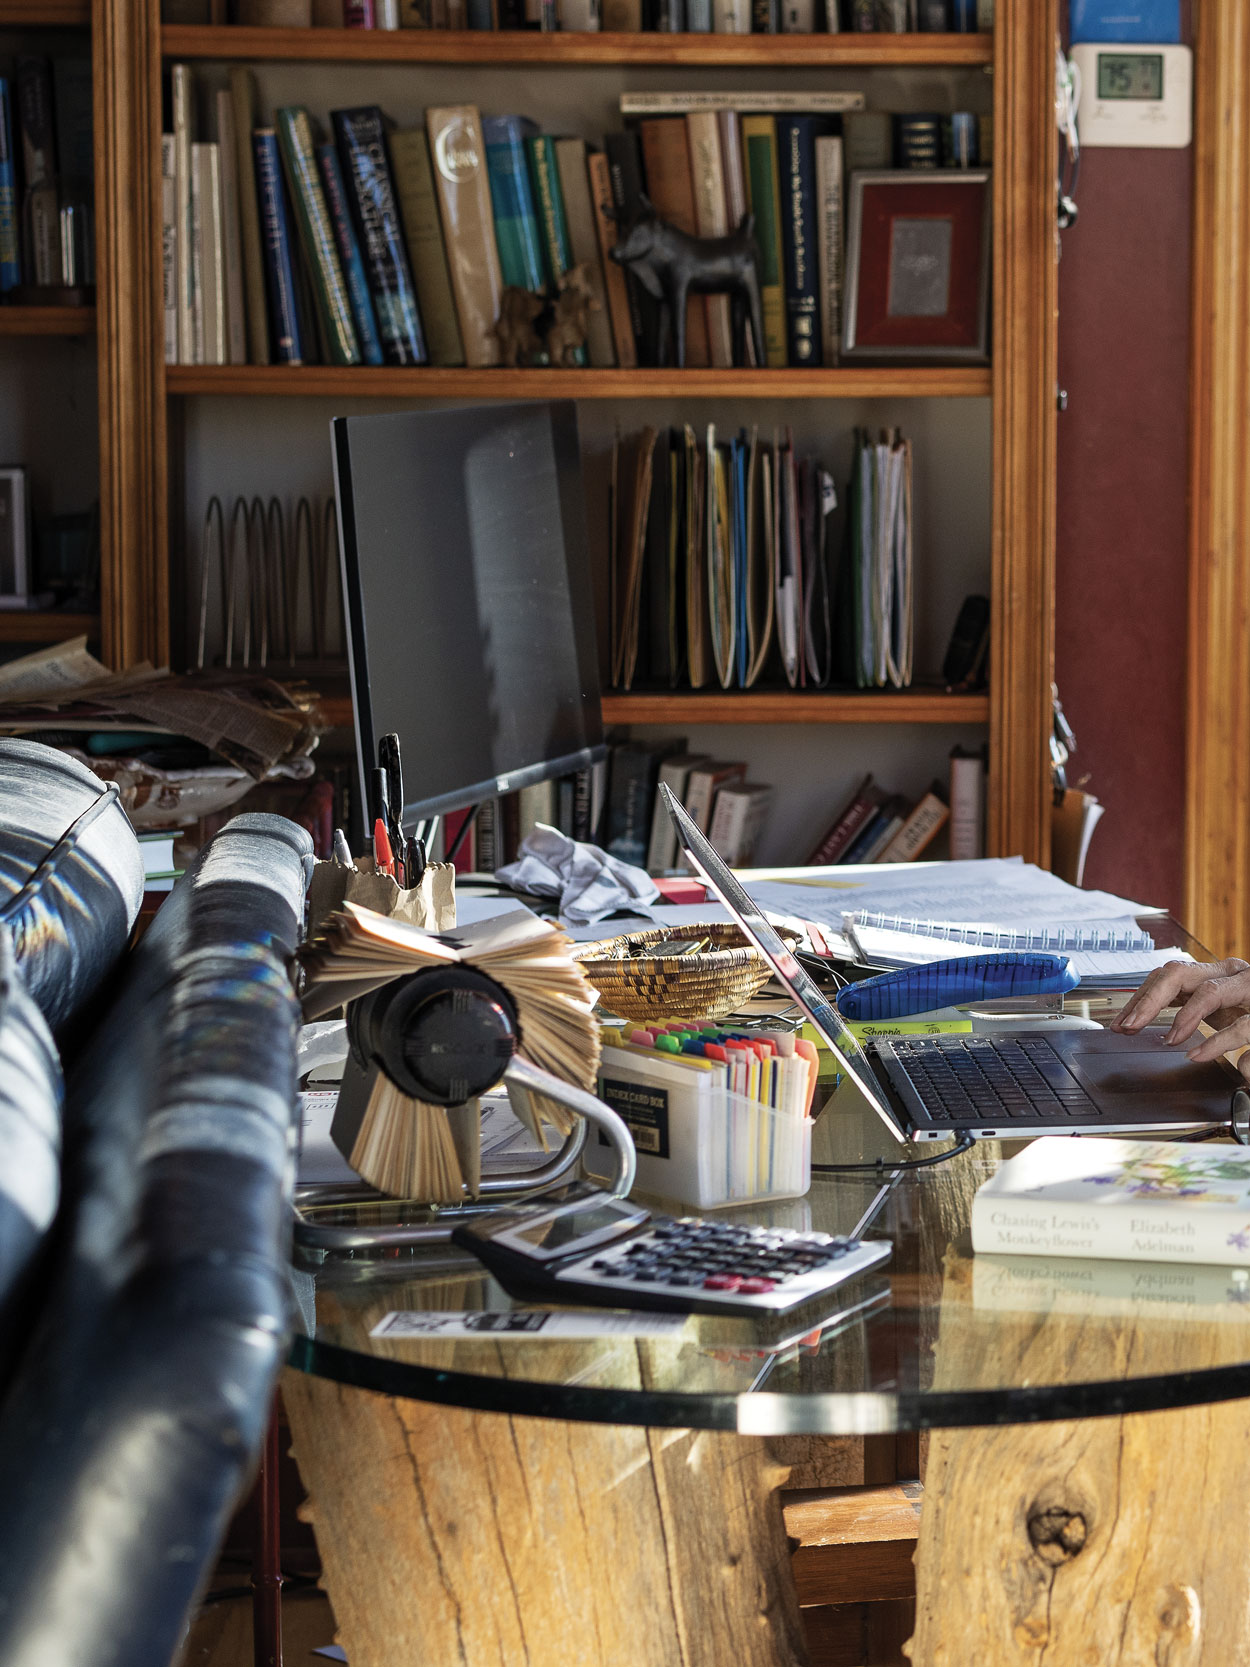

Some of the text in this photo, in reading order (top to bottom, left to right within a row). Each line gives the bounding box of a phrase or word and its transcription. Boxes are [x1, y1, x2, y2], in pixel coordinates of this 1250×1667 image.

[349, 145, 387, 259] LITERATURE
[366, 143, 400, 241] CLASSICAL
[606, 1088, 665, 1109] INDEX CARD BOX
[990, 1210, 1100, 1231] Chasing Lewis's
[1130, 1218, 1196, 1236] Elizabeth
[997, 1230, 1094, 1249] Monkeyflower
[1130, 1238, 1195, 1254] Adelman
